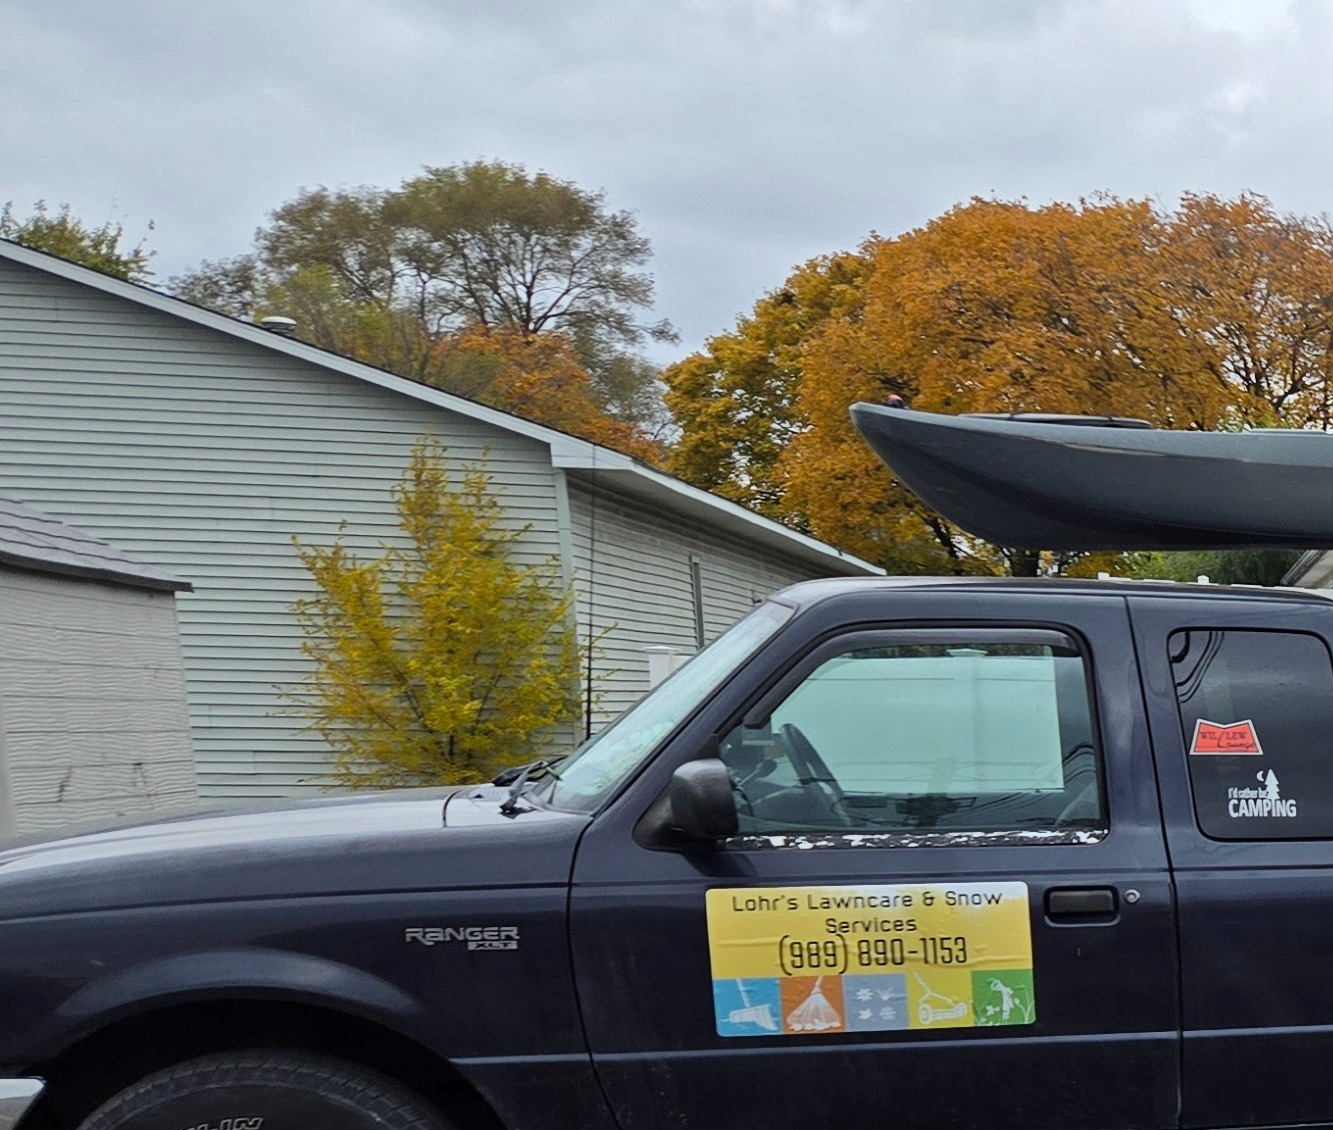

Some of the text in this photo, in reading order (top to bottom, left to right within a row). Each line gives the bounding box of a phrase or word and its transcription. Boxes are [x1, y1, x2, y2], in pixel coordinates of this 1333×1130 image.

[1228, 799, 1297, 817] CAMPING
[733, 891, 1003, 912] Lohr's Lawncare & Snow
[825, 918, 918, 934] Services
[405, 926, 521, 945] RANGER
[473, 941, 511, 950] XLT
[778, 933, 968, 976] (989) 890-1153
